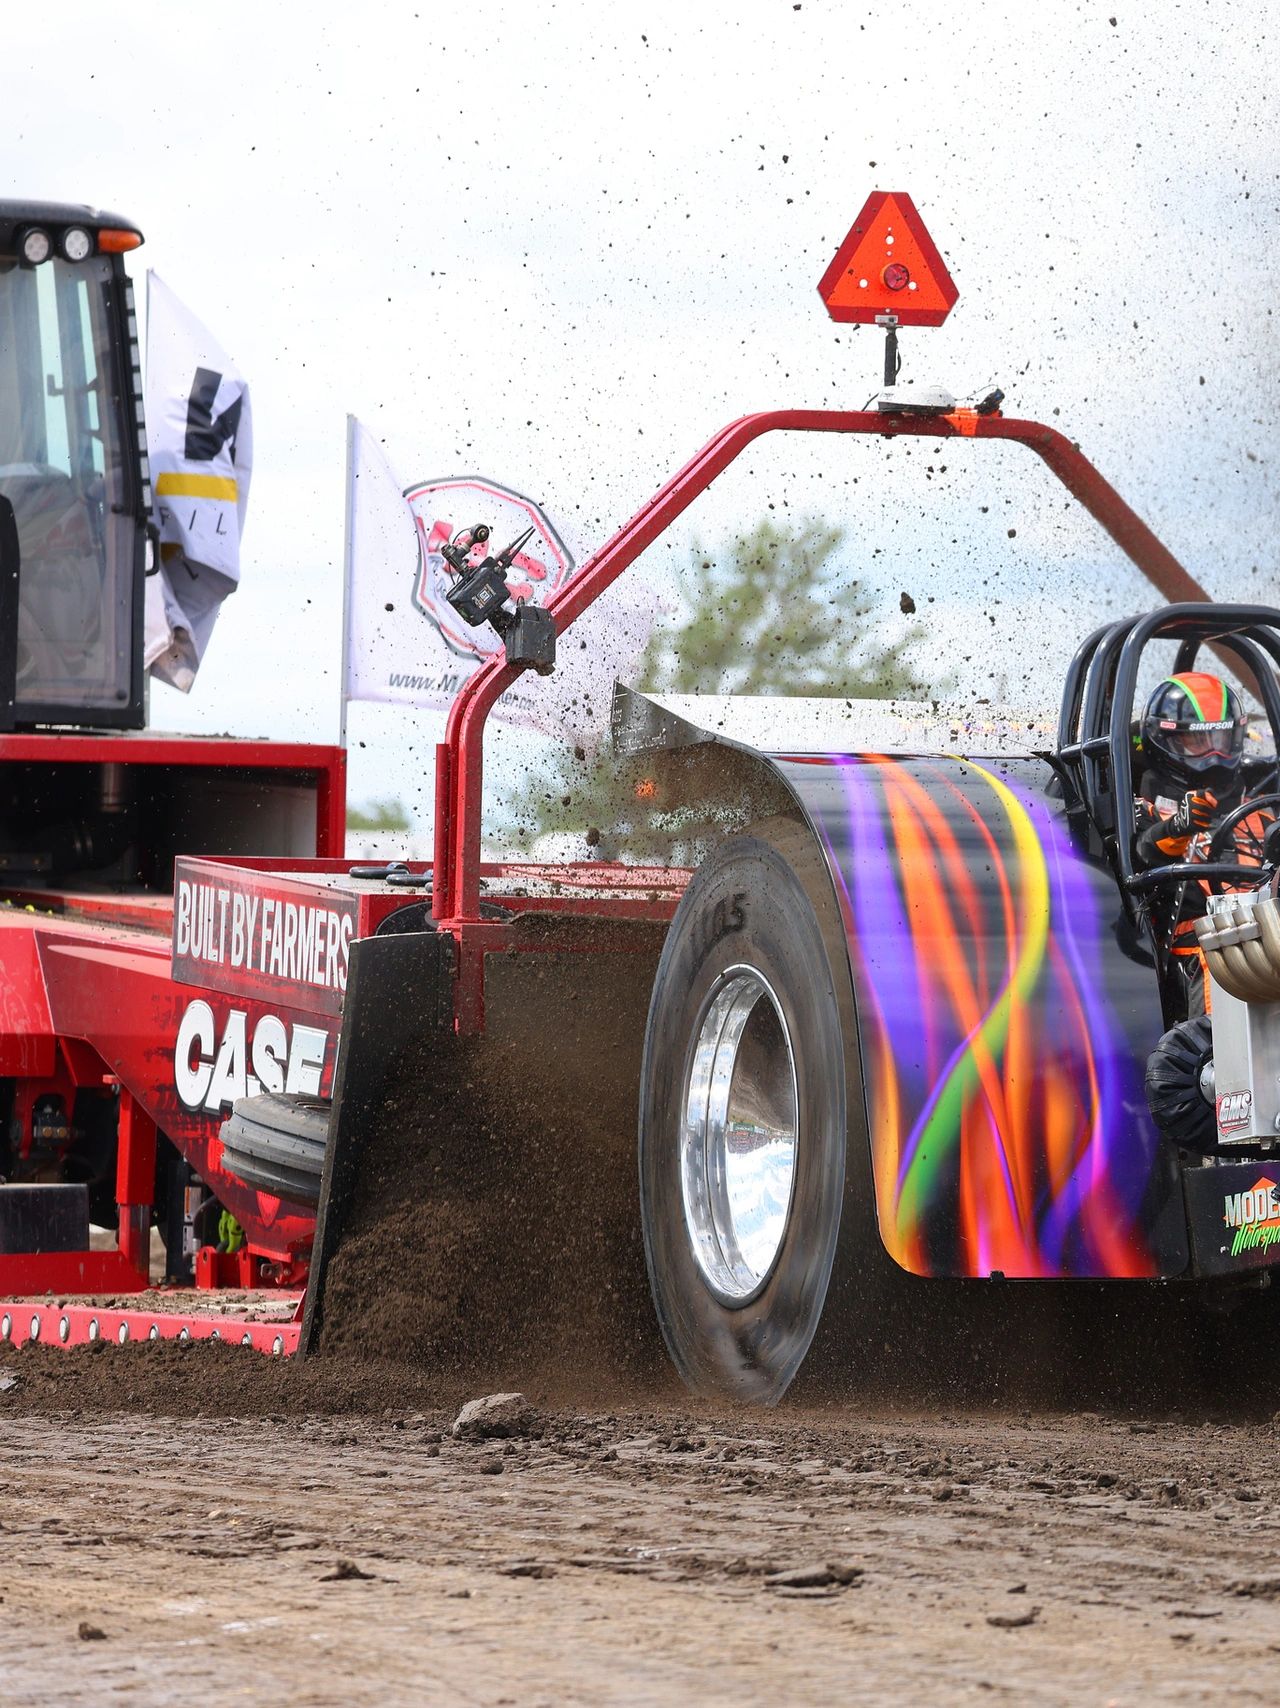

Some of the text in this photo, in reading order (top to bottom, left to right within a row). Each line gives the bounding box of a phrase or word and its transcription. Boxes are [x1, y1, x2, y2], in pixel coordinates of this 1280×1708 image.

[1189, 720, 1234, 731] SIMPSON
[177, 881, 352, 991] BUILT BY FARMERS
[175, 1000, 329, 1110] CASE
[1219, 1091, 1251, 1121] GMS
